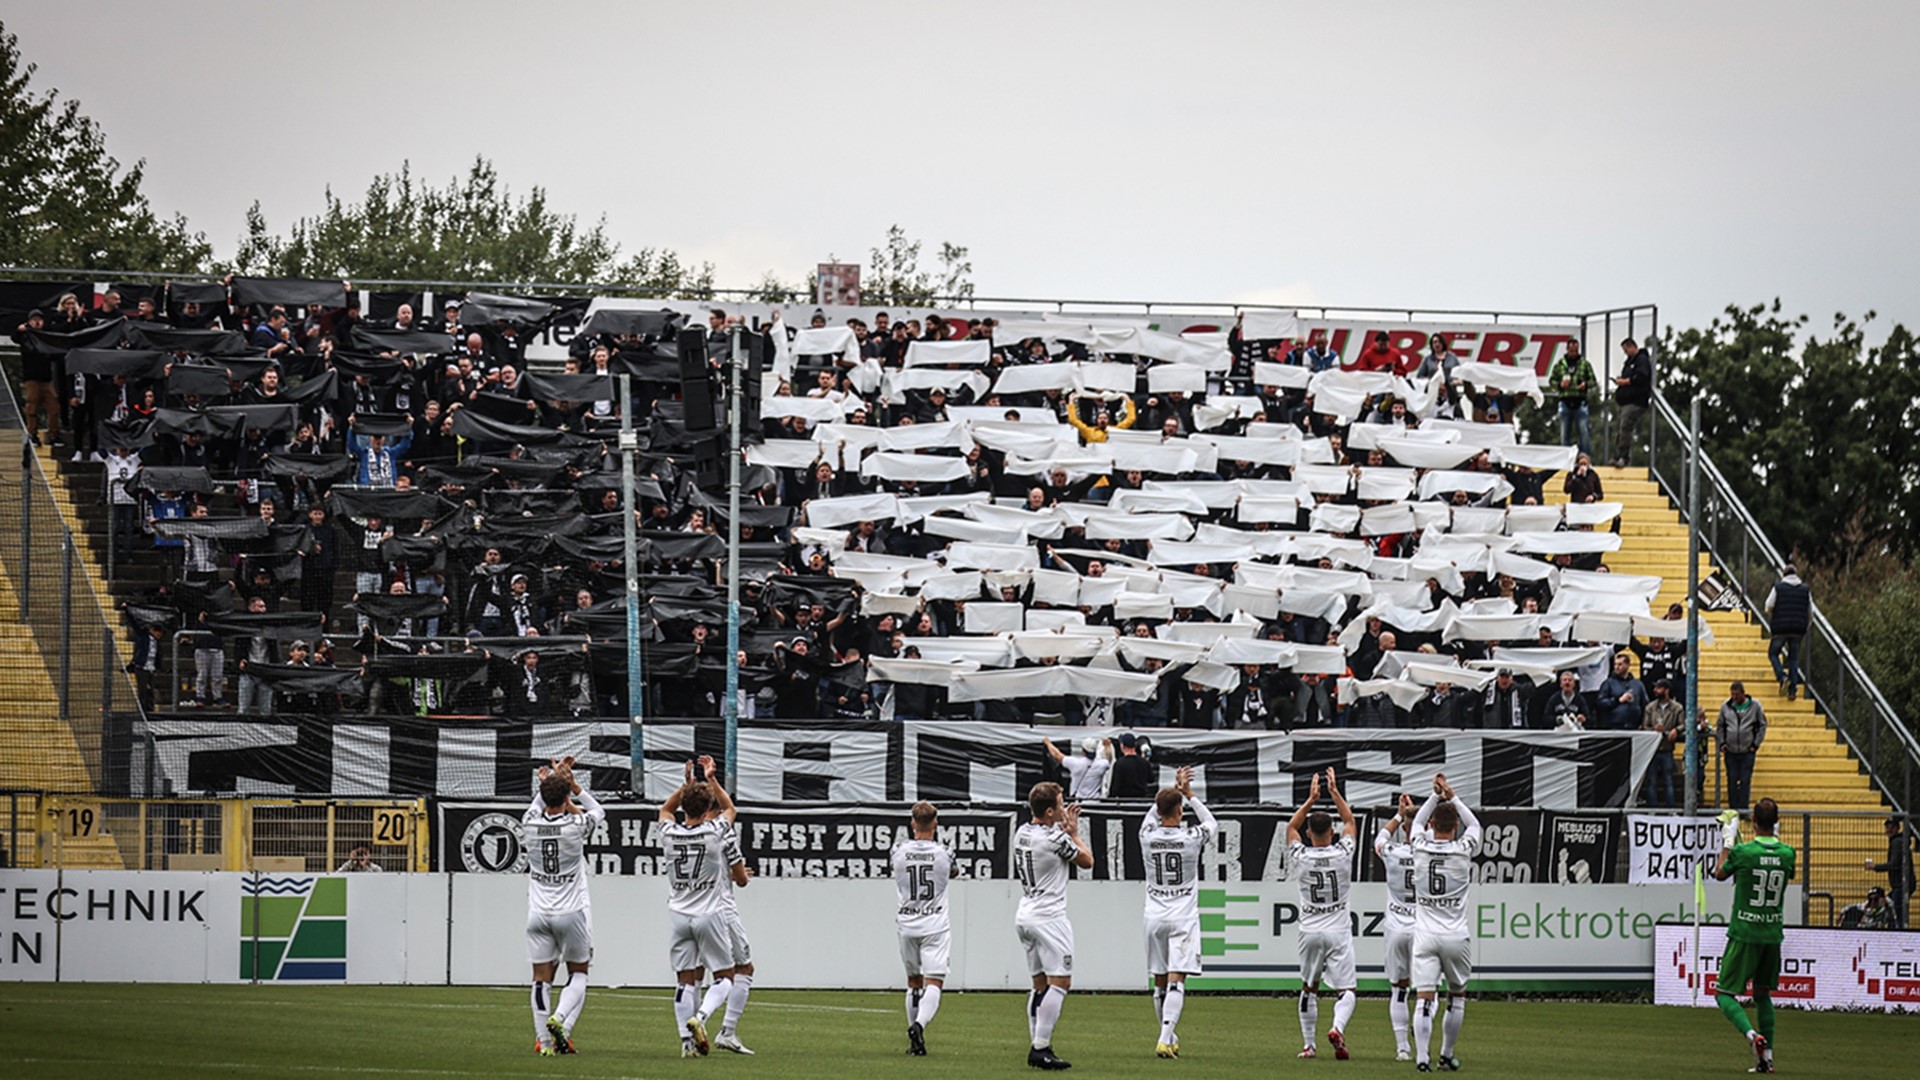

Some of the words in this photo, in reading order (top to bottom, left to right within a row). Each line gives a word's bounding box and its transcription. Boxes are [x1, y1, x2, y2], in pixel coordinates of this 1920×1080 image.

[68, 808, 93, 836] 19
[377, 813, 405, 842] 20
[752, 822, 826, 850] FEST
[837, 824, 995, 851] ZUSAMEN
[1634, 821, 1724, 850] BOYCOT
[541, 838, 560, 875] 8
[673, 844, 706, 880] 27
[1151, 852, 1183, 886] 19
[905, 865, 934, 901] 15
[1309, 870, 1339, 903] 21
[1429, 859, 1447, 896] 6
[1750, 869, 1786, 907] 39
[0, 887, 205, 922] ECHNIK
